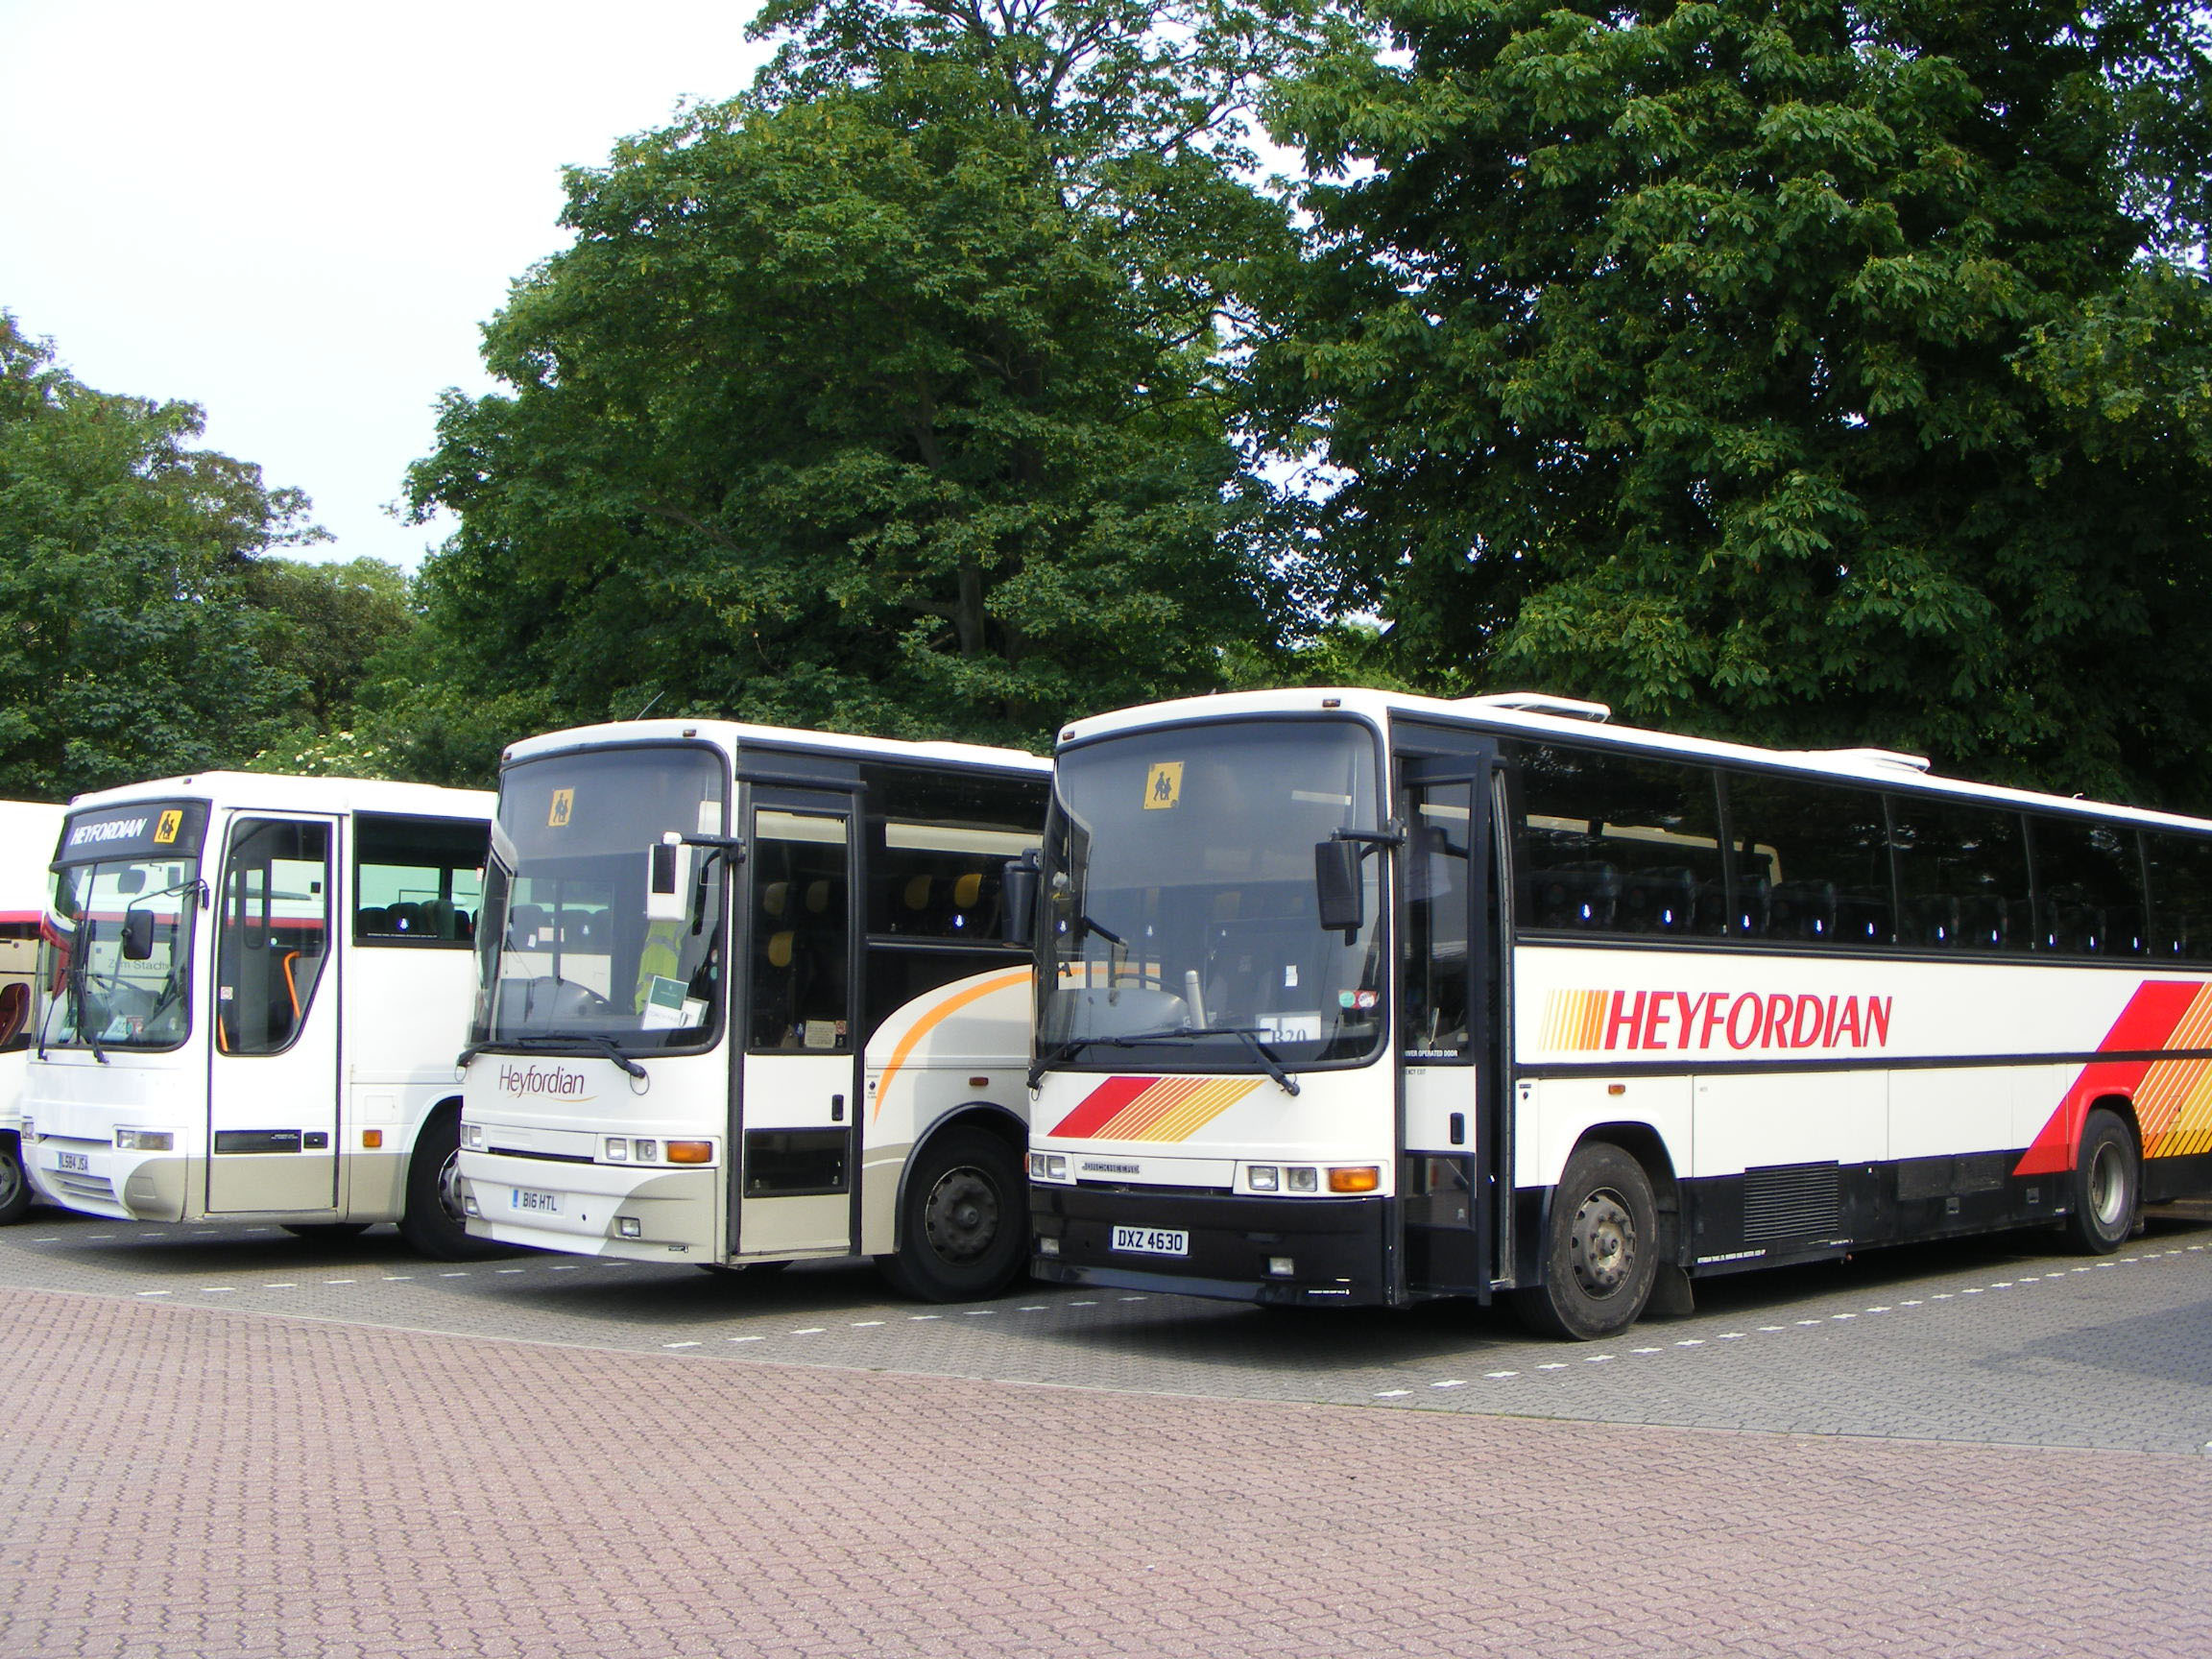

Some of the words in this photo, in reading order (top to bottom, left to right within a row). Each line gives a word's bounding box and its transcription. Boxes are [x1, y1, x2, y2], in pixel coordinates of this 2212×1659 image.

[70, 818, 148, 846] HEYFORDIAN
[1604, 990, 1893, 1050] HEYFORDIAN
[499, 1064, 585, 1098] Heyfordian
[522, 1192, 538, 1209] B16
[539, 1194, 557, 1211] HTL
[1118, 1230, 1144, 1248] DXZ
[1147, 1232, 1183, 1251] 4630
